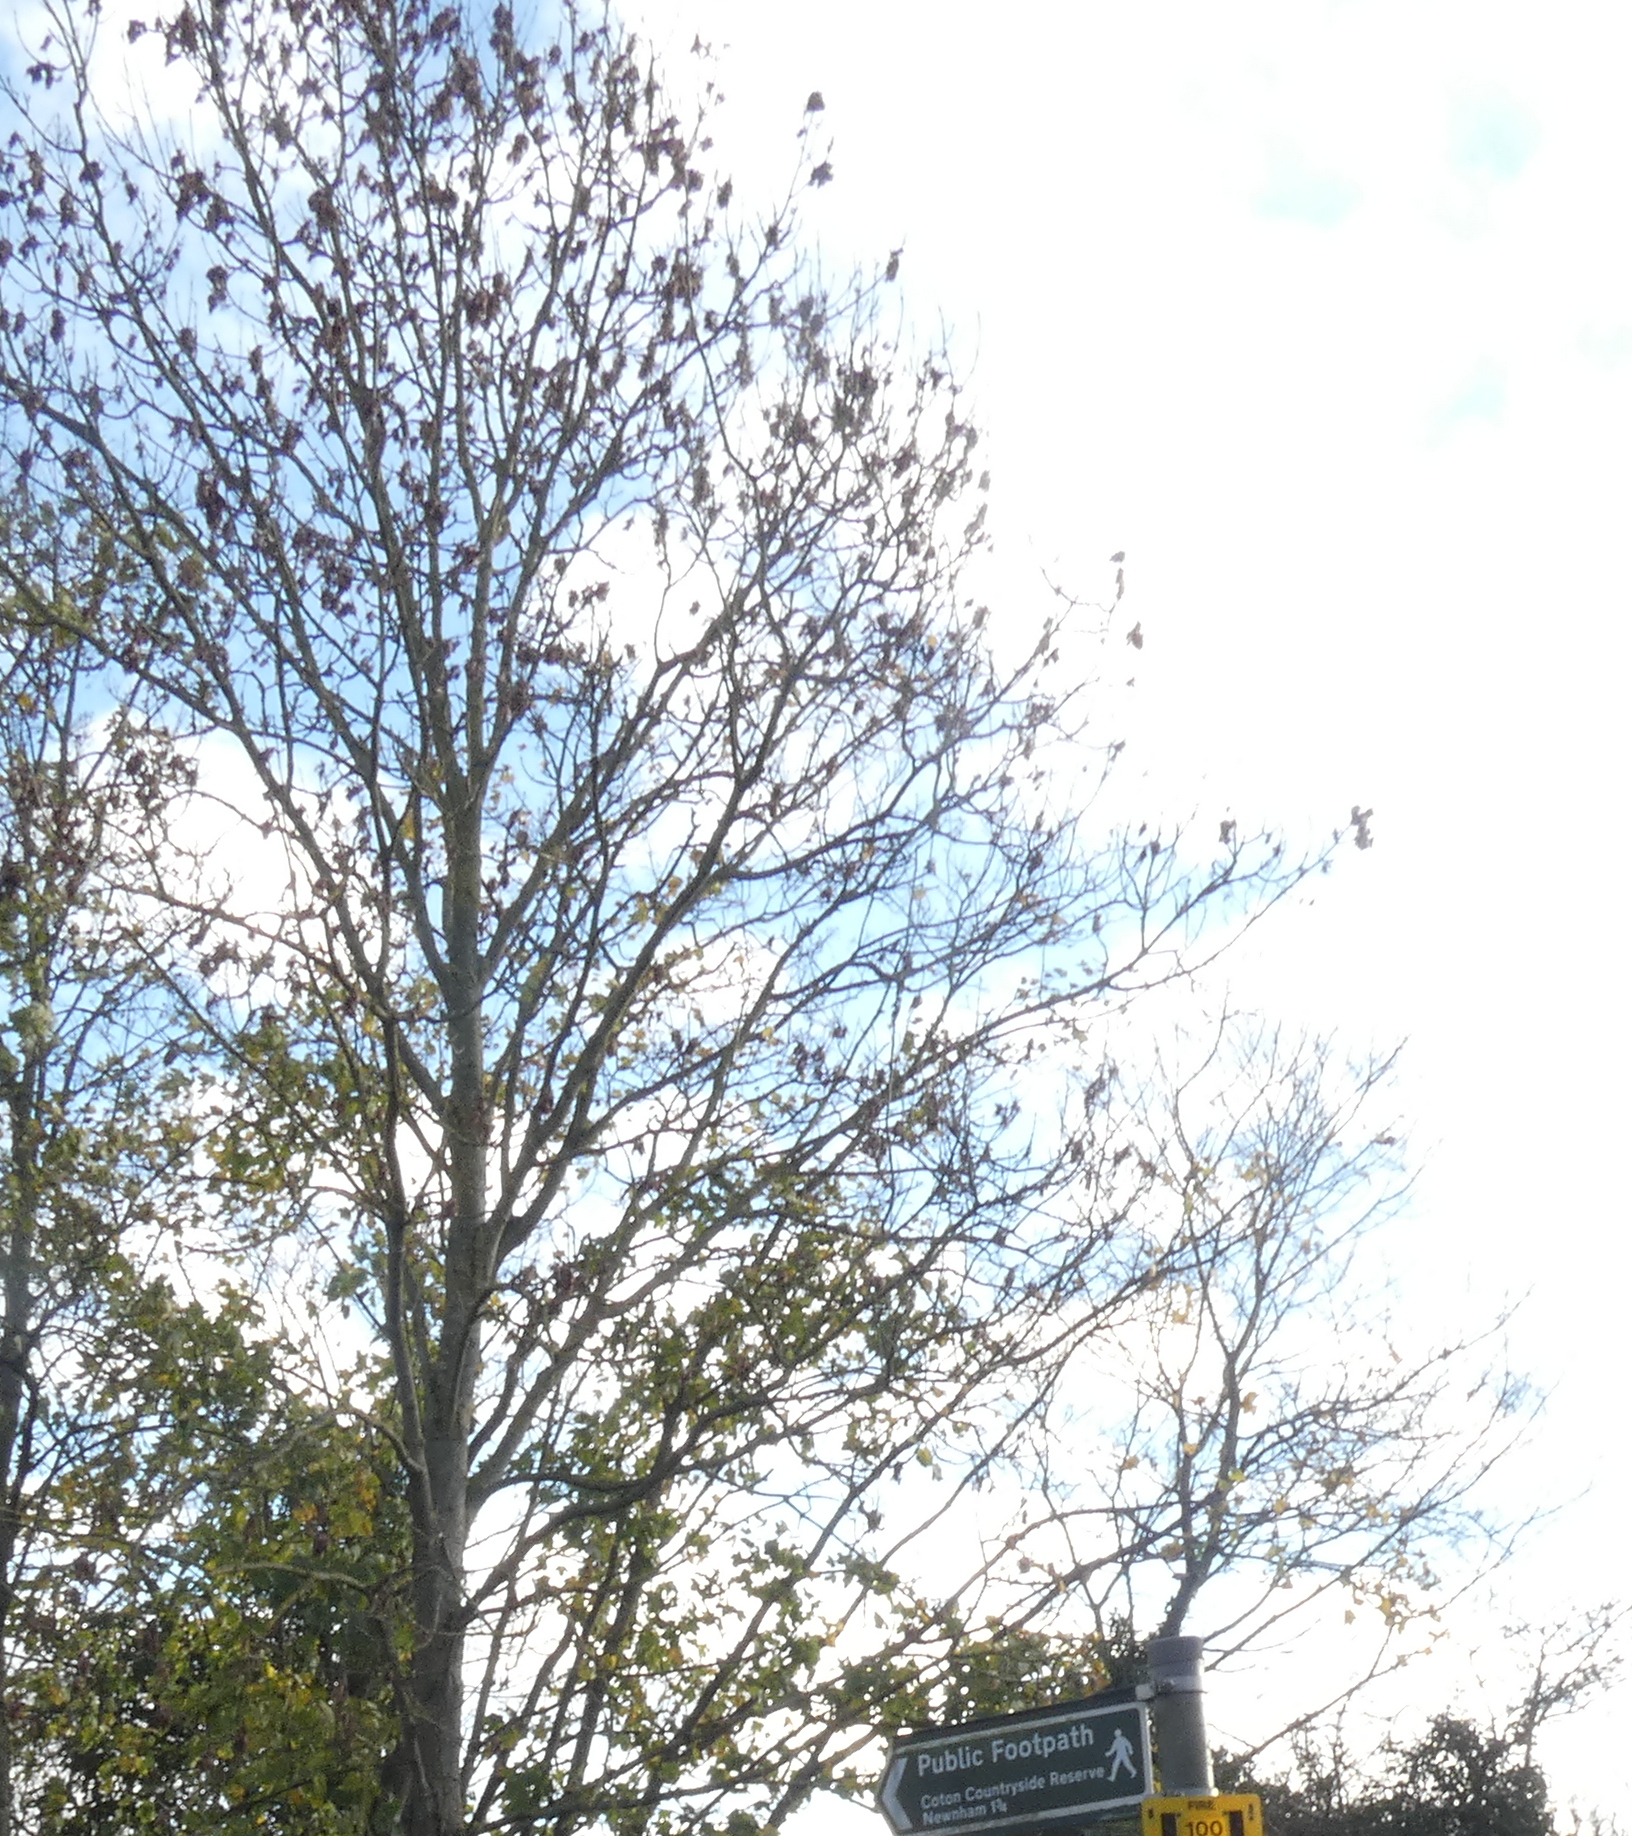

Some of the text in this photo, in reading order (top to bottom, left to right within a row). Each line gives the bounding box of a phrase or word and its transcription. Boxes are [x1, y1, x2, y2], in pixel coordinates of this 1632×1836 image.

[918, 1723, 1095, 1777] Public Footpath
[921, 1766, 1105, 1810] Coton Countryside Reserve
[922, 1804, 987, 1825] Newnham
